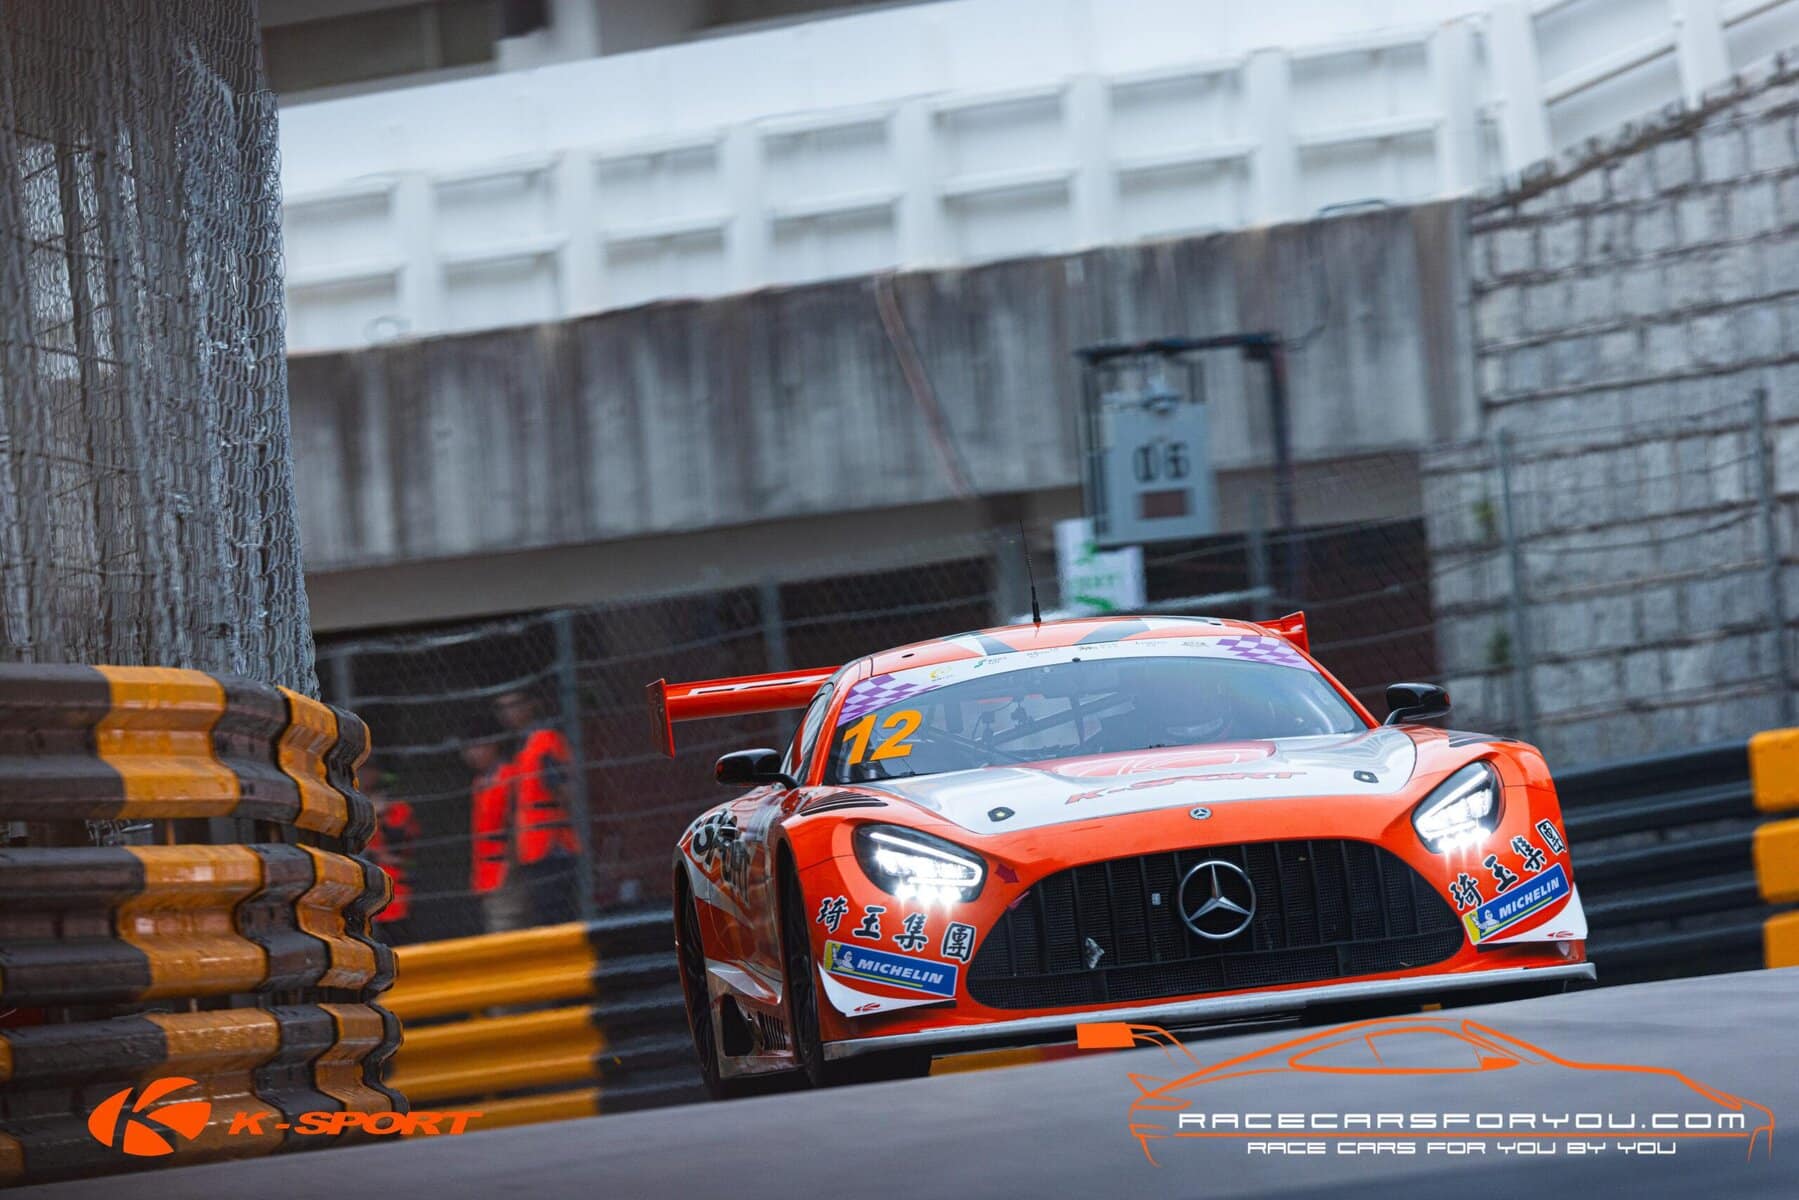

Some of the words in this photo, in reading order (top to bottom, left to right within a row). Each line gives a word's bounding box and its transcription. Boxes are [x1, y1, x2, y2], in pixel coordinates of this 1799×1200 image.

[843, 709, 923, 765] 12
[1499, 876, 1561, 920] MICHELIN
[856, 957, 945, 985] MICHELIN
